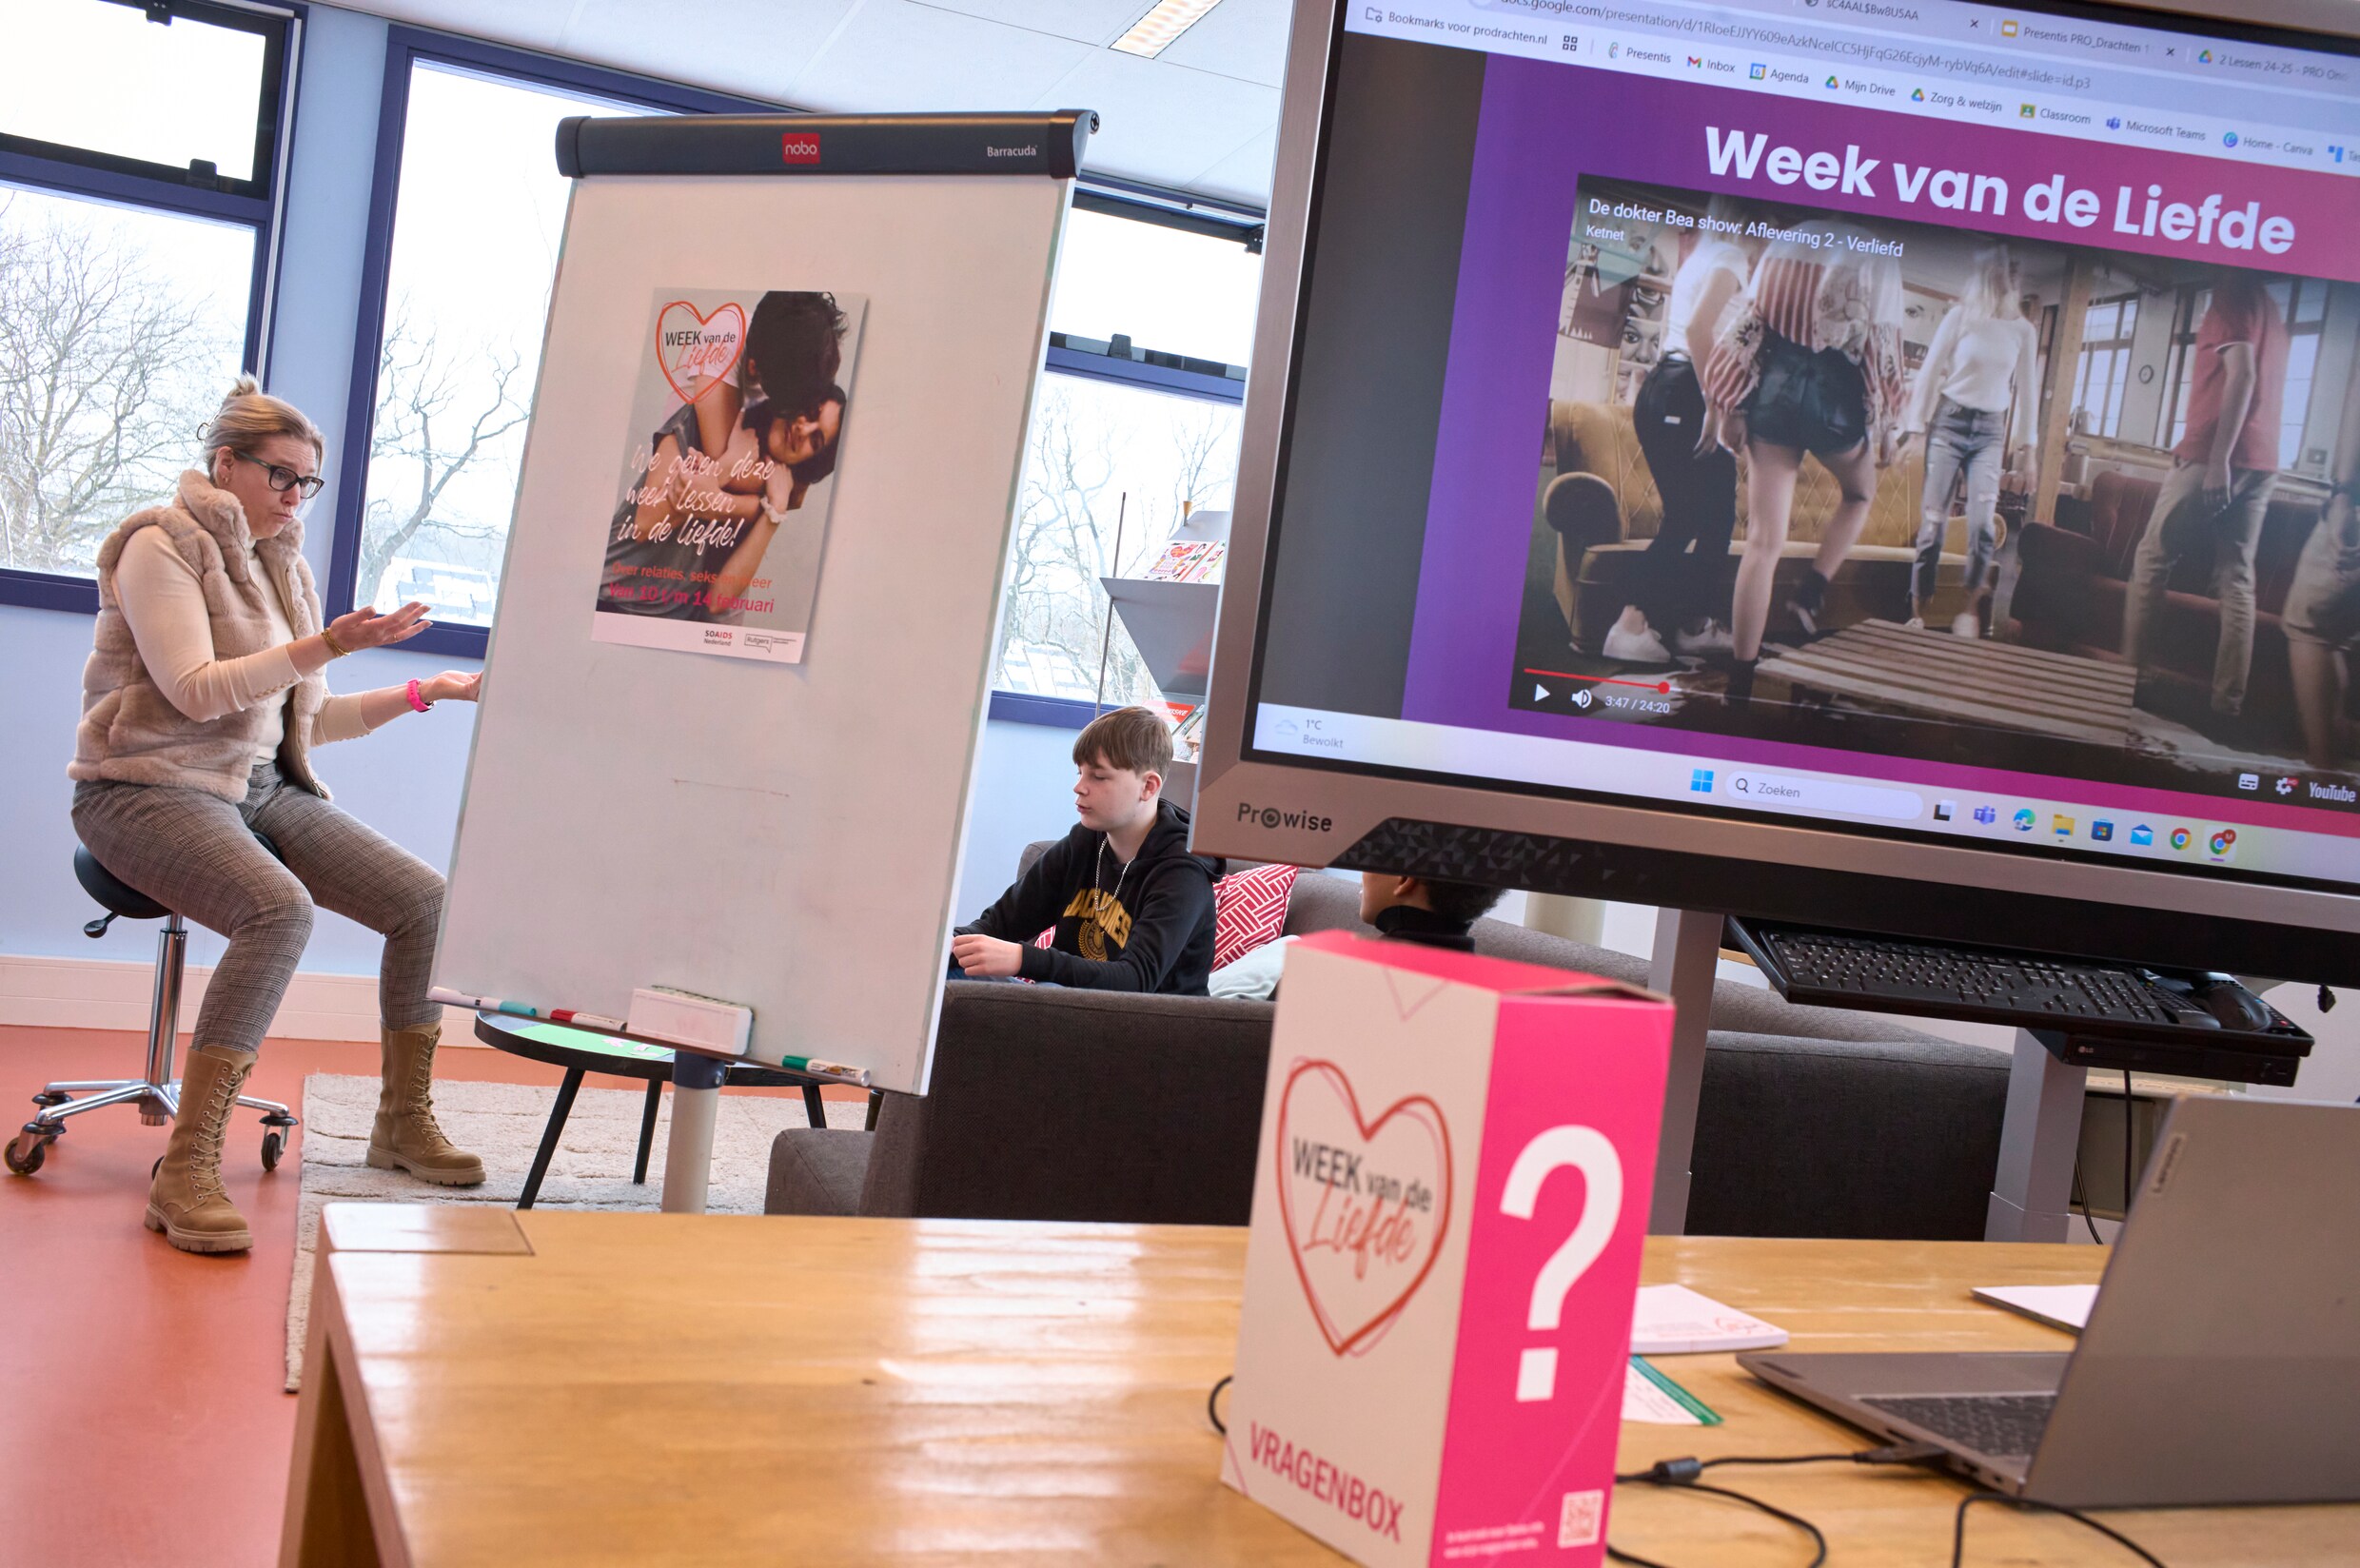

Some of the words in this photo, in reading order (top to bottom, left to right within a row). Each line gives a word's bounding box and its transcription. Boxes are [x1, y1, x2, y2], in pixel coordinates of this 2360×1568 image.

[1388, 11, 1445, 29] Bookmarks
[1447, 23, 1470, 35] voor
[1473, 25, 1547, 46] prodrachten.nl
[2024, 27, 2067, 42] Presentis
[1626, 47, 1672, 64] Presentis
[1707, 59, 1736, 73] Inbox
[1770, 69, 1809, 84] Agenda
[1844, 80, 1867, 94] Mijn
[1869, 83, 1896, 96] Drive
[1931, 92, 1955, 107] Zorg
[1957, 96, 1966, 107] &
[1969, 99, 2002, 113] welzijn
[2039, 108, 2092, 125] Classroom
[2126, 120, 2173, 136] Microsoft
[2177, 127, 2207, 142] Teams
[785, 141, 817, 155] nobo
[987, 145, 1037, 157] Barracuda
[2243, 137, 2273, 150] Home
[2283, 142, 2313, 156] Canva
[1704, 126, 1883, 198] Week
[1893, 161, 2009, 217] van
[2023, 174, 2101, 228] de
[2113, 183, 2296, 255] Liefde
[1585, 225, 1624, 242] Ketnet
[1589, 199, 1610, 216] De
[1614, 201, 1662, 223] dokter
[1665, 208, 1694, 227] Bea
[1698, 216, 1743, 235] show:
[1745, 222, 1821, 248] Aflevering
[1823, 232, 1834, 247] 2
[1847, 234, 1903, 258] Verliefd
[665, 330, 702, 346] WEEK
[704, 335, 721, 343] van
[723, 331, 737, 343] de
[671, 340, 729, 376] Liefde
[631, 442, 662, 474] We
[668, 454, 723, 482] geven
[730, 451, 777, 480] deze
[625, 476, 671, 508] week
[676, 480, 737, 513] lessen
[617, 515, 641, 541] in
[648, 514, 674, 543] de
[677, 513, 745, 557] liefde!
[612, 562, 639, 577] Over
[690, 573, 718, 584] seks
[608, 582, 635, 599] Van
[639, 586, 659, 601] 10
[661, 588, 689, 604] t/m
[692, 591, 712, 607] 14
[716, 592, 775, 614] februari
[703, 637, 732, 647] Nederland
[1604, 695, 1630, 709] 3:47
[1639, 699, 1671, 715] 24:20
[1306, 719, 1323, 731] 1°C
[1303, 734, 1344, 749] Bewolkt
[1758, 782, 1801, 798] Zoeken
[2309, 781, 2357, 803] YouTube
[1237, 802, 1332, 833] Prowise
[1293, 1136, 1363, 1194] WEEK
[1367, 1172, 1403, 1203] van
[1405, 1177, 1432, 1213] de
[1303, 1176, 1417, 1281] Liefde
[1500, 1125, 1623, 1402] ?
[1250, 1421, 1404, 1544] VRAGENBOX
